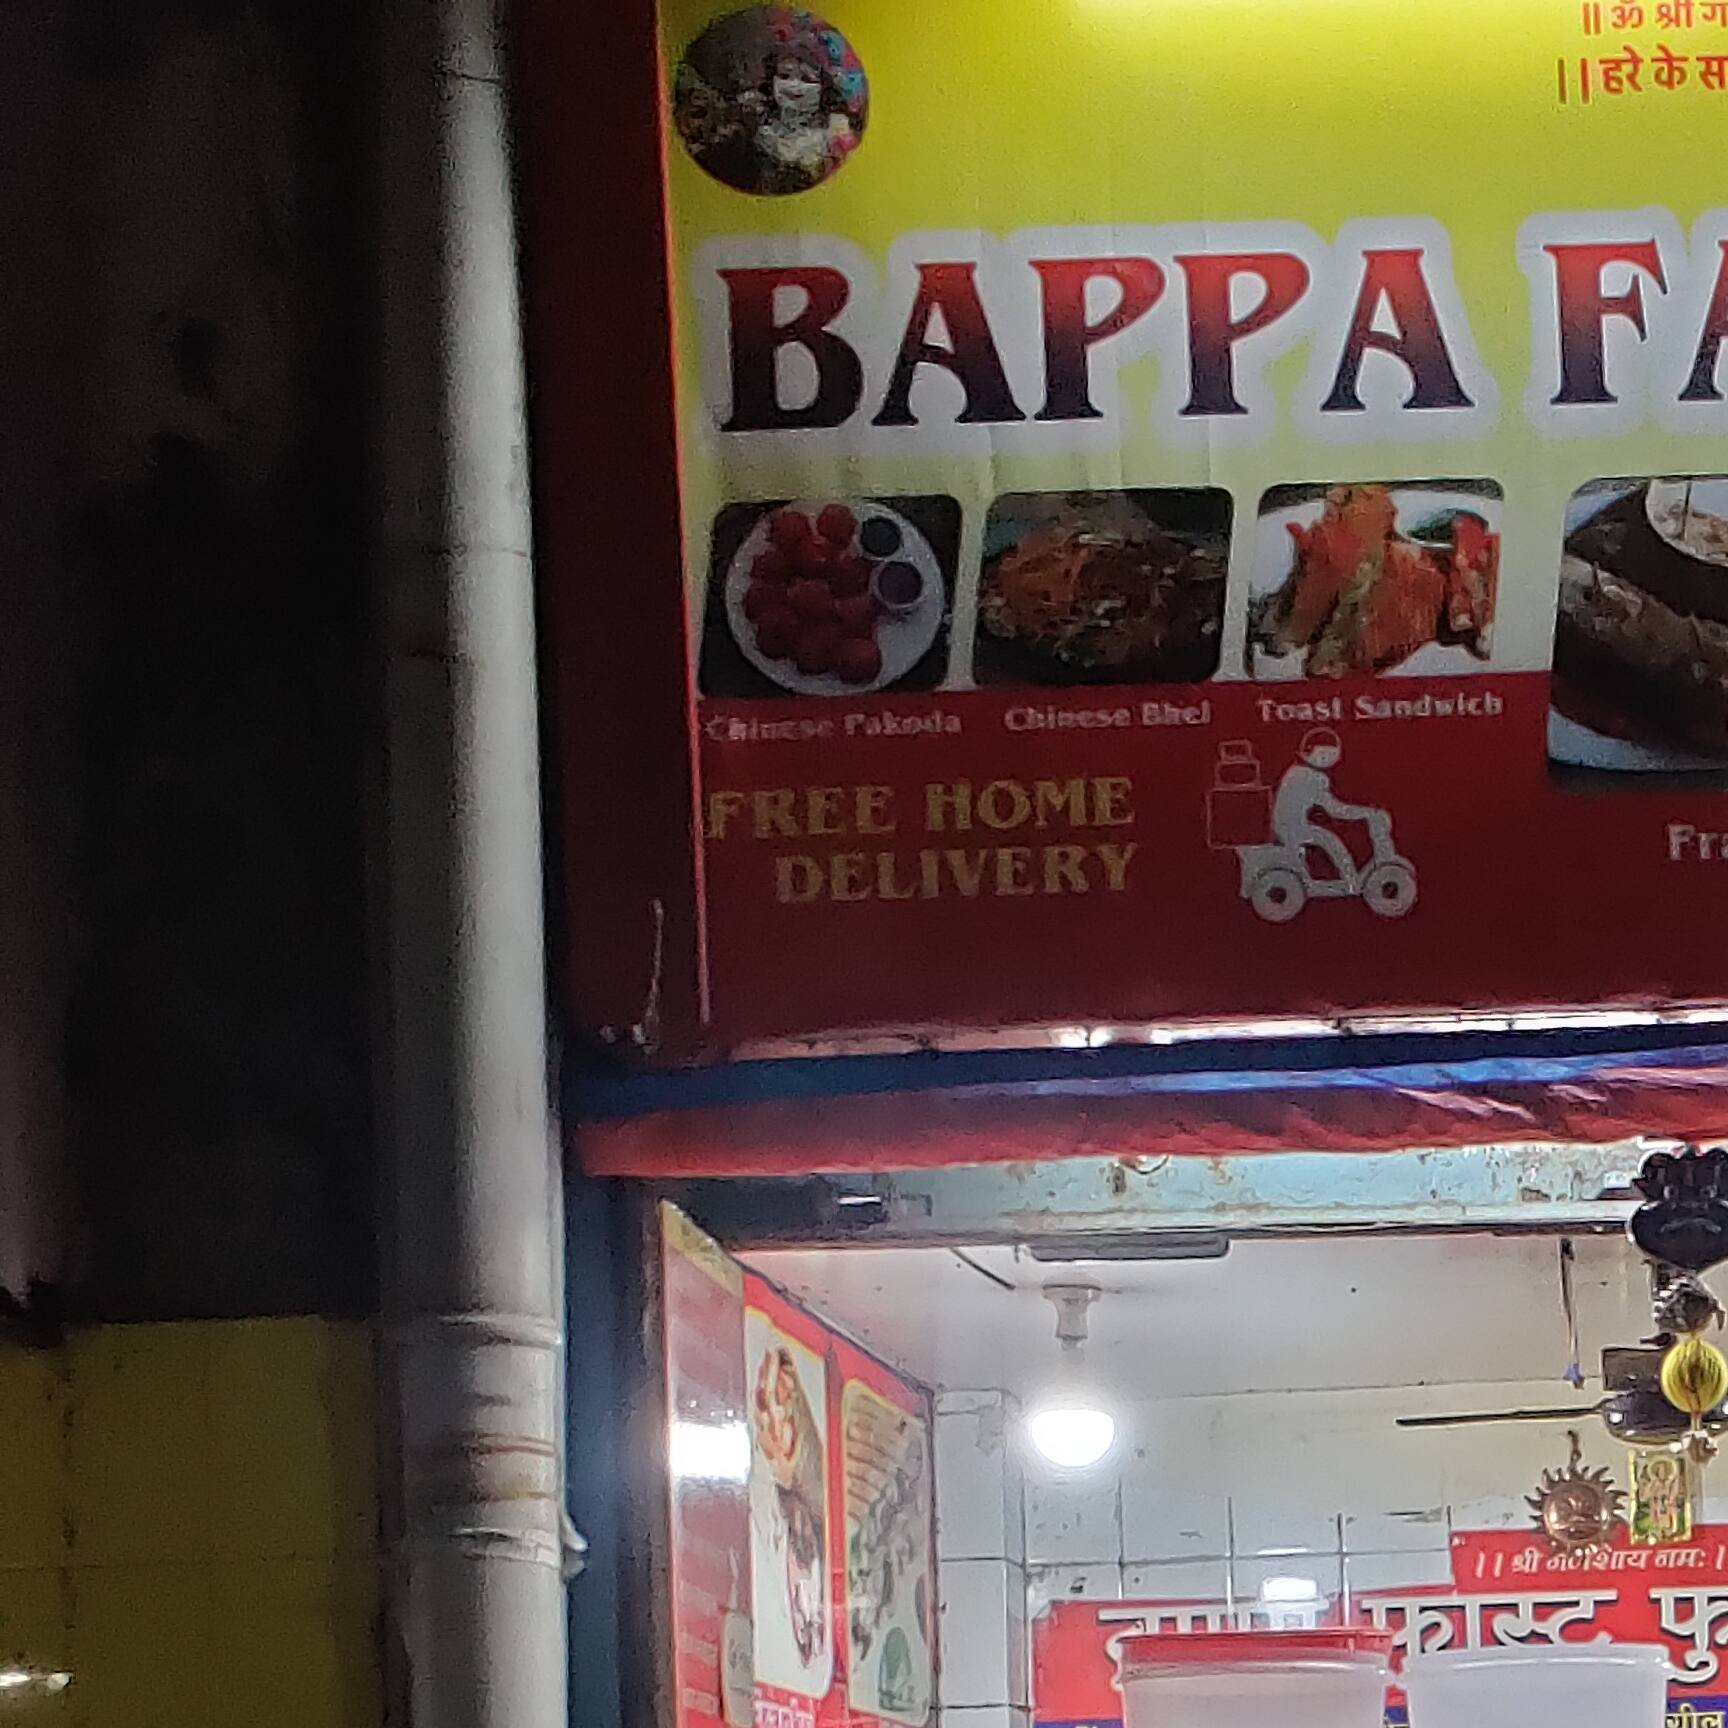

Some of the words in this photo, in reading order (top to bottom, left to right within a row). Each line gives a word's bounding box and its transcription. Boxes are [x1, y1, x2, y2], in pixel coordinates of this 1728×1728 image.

[1600, 45, 1643, 95] हरे
[1651, 43, 1688, 90] के
[716, 248, 1475, 432] BAPPA
[1005, 704, 1132, 732] Chinese
[1141, 698, 1211, 727] Bhel
[1258, 697, 1344, 723] Toast
[1354, 690, 1503, 720] Sandwich
[703, 784, 898, 839] FREE
[923, 776, 1136, 832] HOME
[775, 842, 1138, 903] DELIVERY
